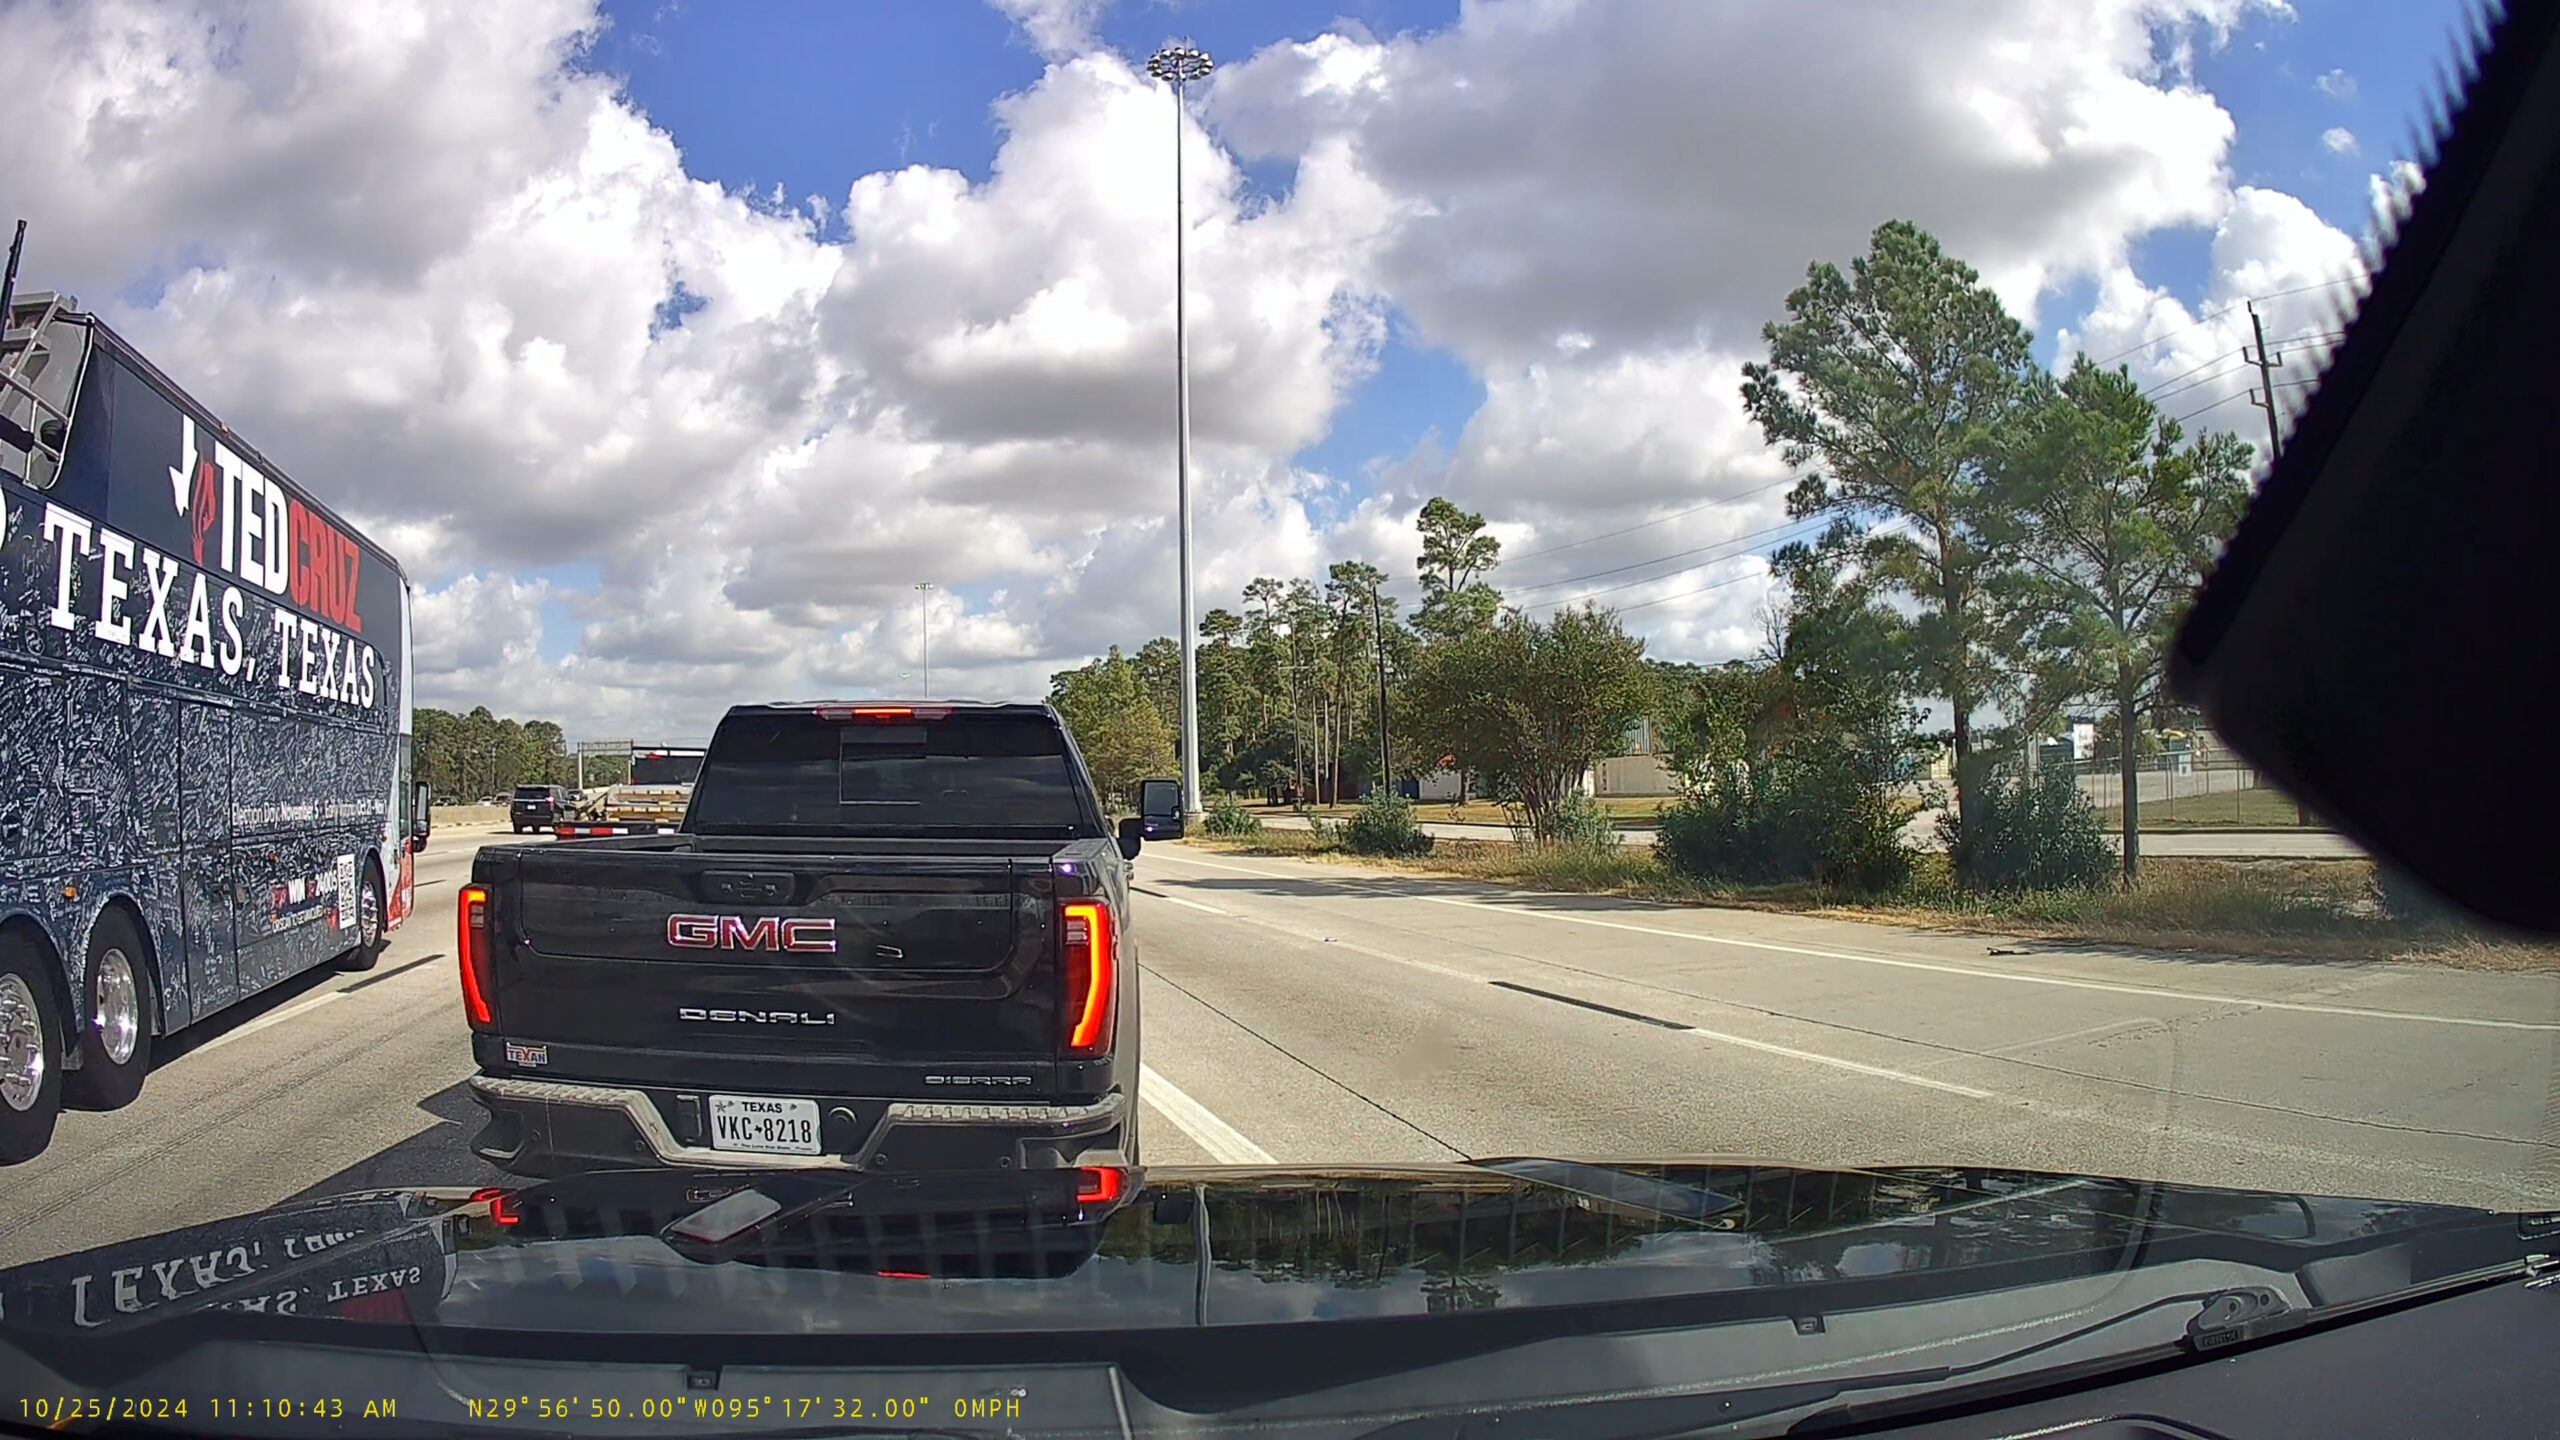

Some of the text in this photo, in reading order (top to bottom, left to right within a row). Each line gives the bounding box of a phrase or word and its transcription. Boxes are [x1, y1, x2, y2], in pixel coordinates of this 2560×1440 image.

[214, 440, 364, 633] TED CRUZ
[43, 502, 256, 682] TEXAS,
[274, 608, 374, 709] TEXAS
[667, 913, 836, 952] GMC
[679, 1008, 836, 1025] DENALI
[507, 1047, 547, 1063] TEXAN
[925, 1075, 1032, 1085] SIERRA
[741, 1101, 783, 1114] TEXAS
